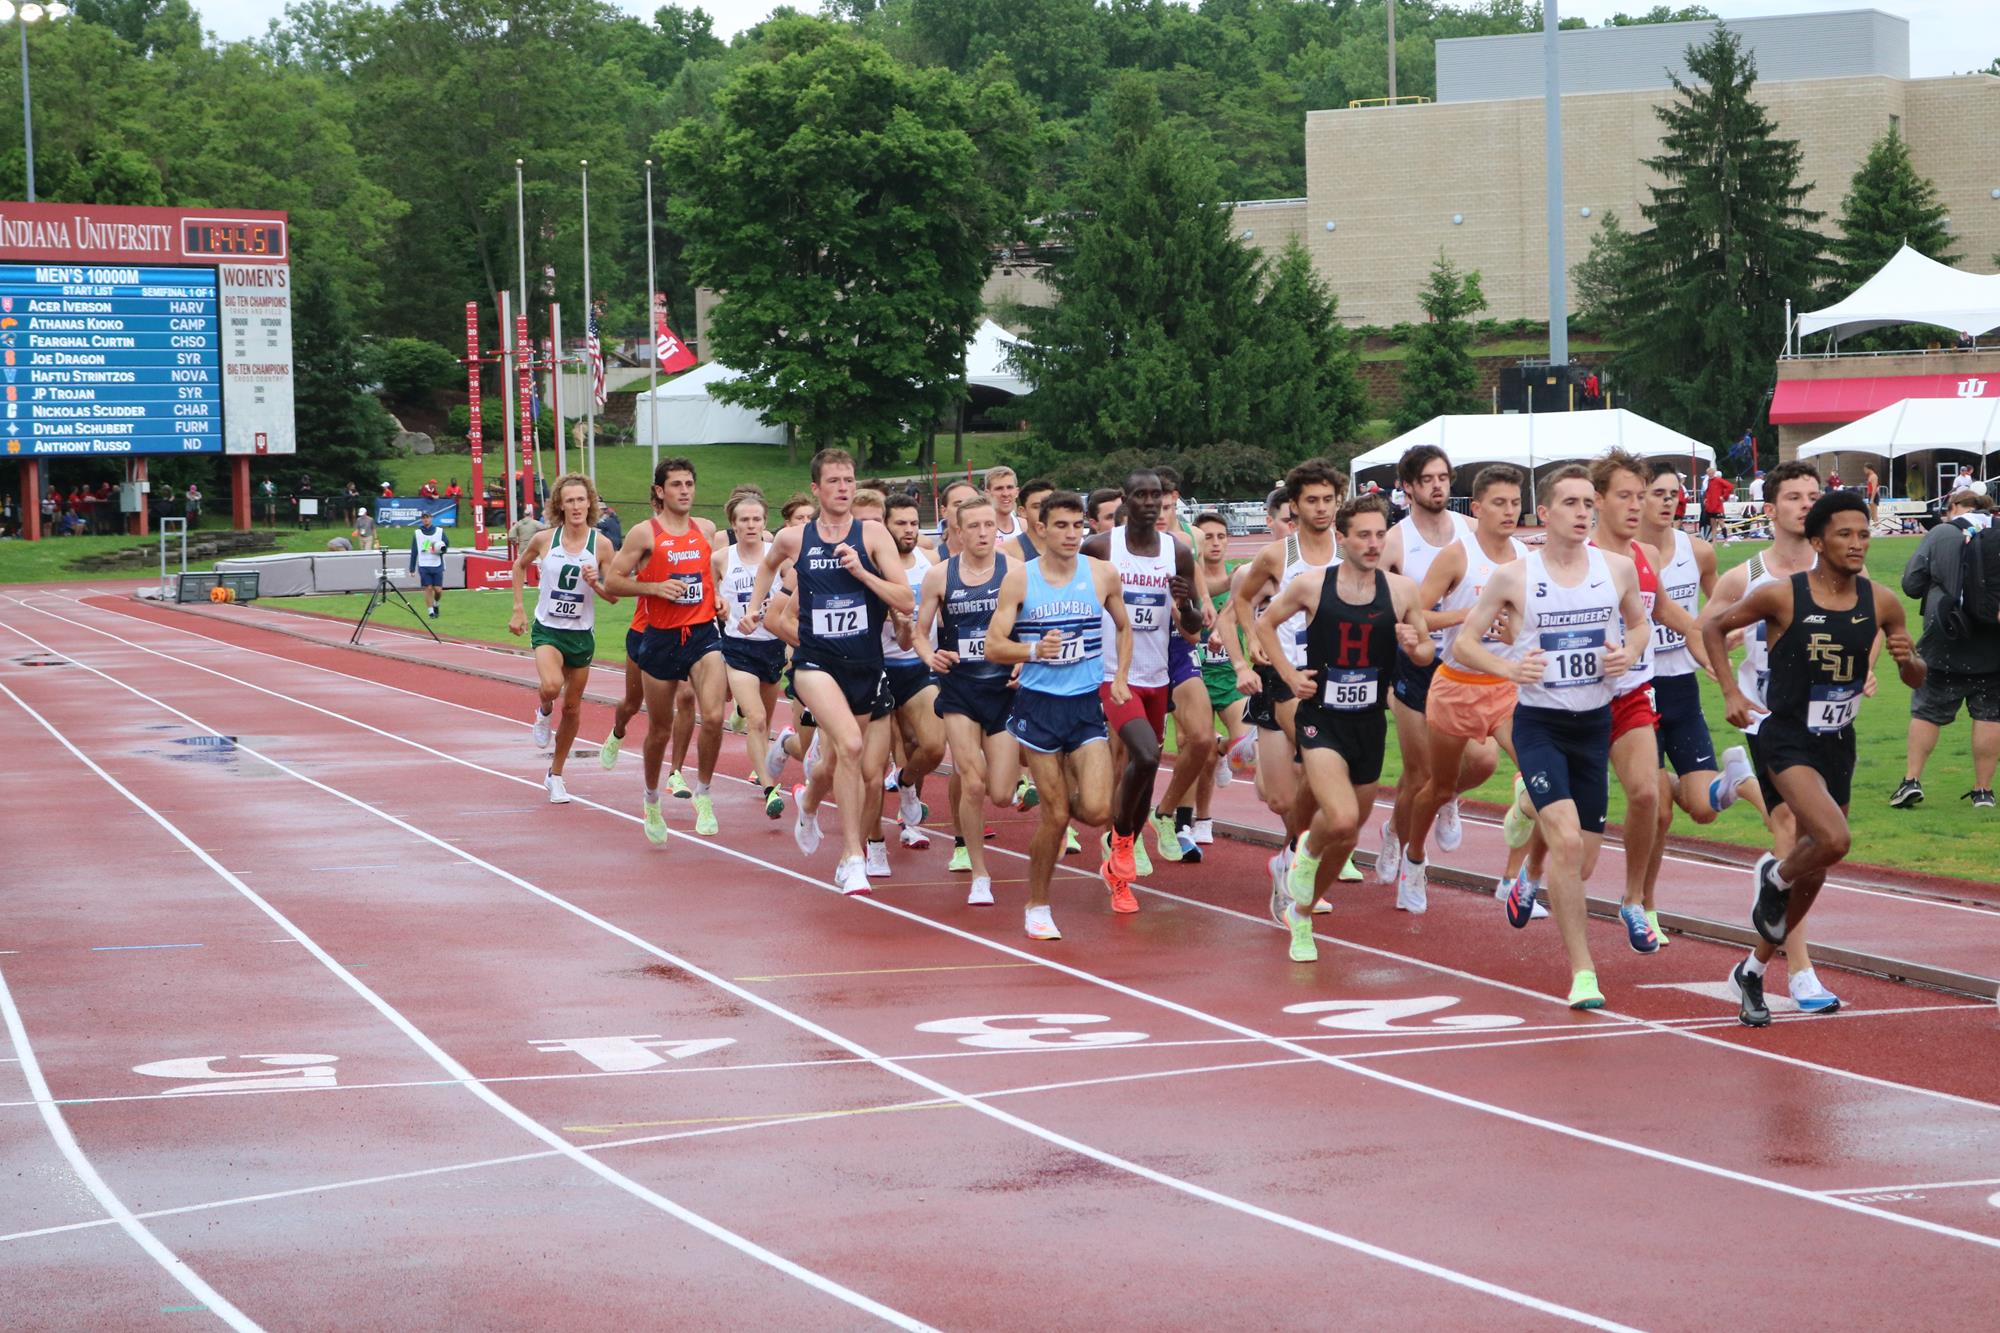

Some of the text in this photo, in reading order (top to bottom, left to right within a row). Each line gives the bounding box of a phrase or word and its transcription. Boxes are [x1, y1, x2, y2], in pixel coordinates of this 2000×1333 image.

[74, 216, 172, 251] UNIVERSITY
[36, 268, 139, 284] MEN'S 10000M
[223, 268, 286, 287] WOMEN'S
[62, 286, 113, 296] START LIST
[142, 287, 188, 297] SEMIFINAL
[170, 301, 204, 313] HARV
[225, 295, 287, 308] BIG TEN CHAMPIONS
[170, 318, 206, 330] CAMP
[467, 328, 477, 336] 20
[171, 335, 206, 348] CHSO
[177, 353, 201, 365] SYR
[171, 370, 208, 382] NOVA
[178, 387, 202, 399] SYR
[173, 404, 208, 416] CHAR
[176, 421, 208, 433] FURM
[183, 438, 202, 450] ND
[475, 504, 484, 534] UCS
[667, 550, 701, 566] Syracuse
[805, 558, 843, 570] BUTL
[1120, 573, 1169, 589] ALABAMA
[555, 602, 577, 614] 202
[947, 598, 999, 615] GEORGETO
[1029, 601, 1093, 621] COLUMBIA
[824, 610, 858, 632] 172
[1134, 608, 1153, 625] 54
[1539, 608, 1613, 627] BUCCANEERS
[1802, 614, 1827, 624] ACC
[1336, 621, 1374, 668] H
[1806, 633, 1854, 681] FSU
[1556, 652, 1597, 679] 188
[1336, 685, 1368, 703] 556
[1822, 702, 1853, 724] 474
